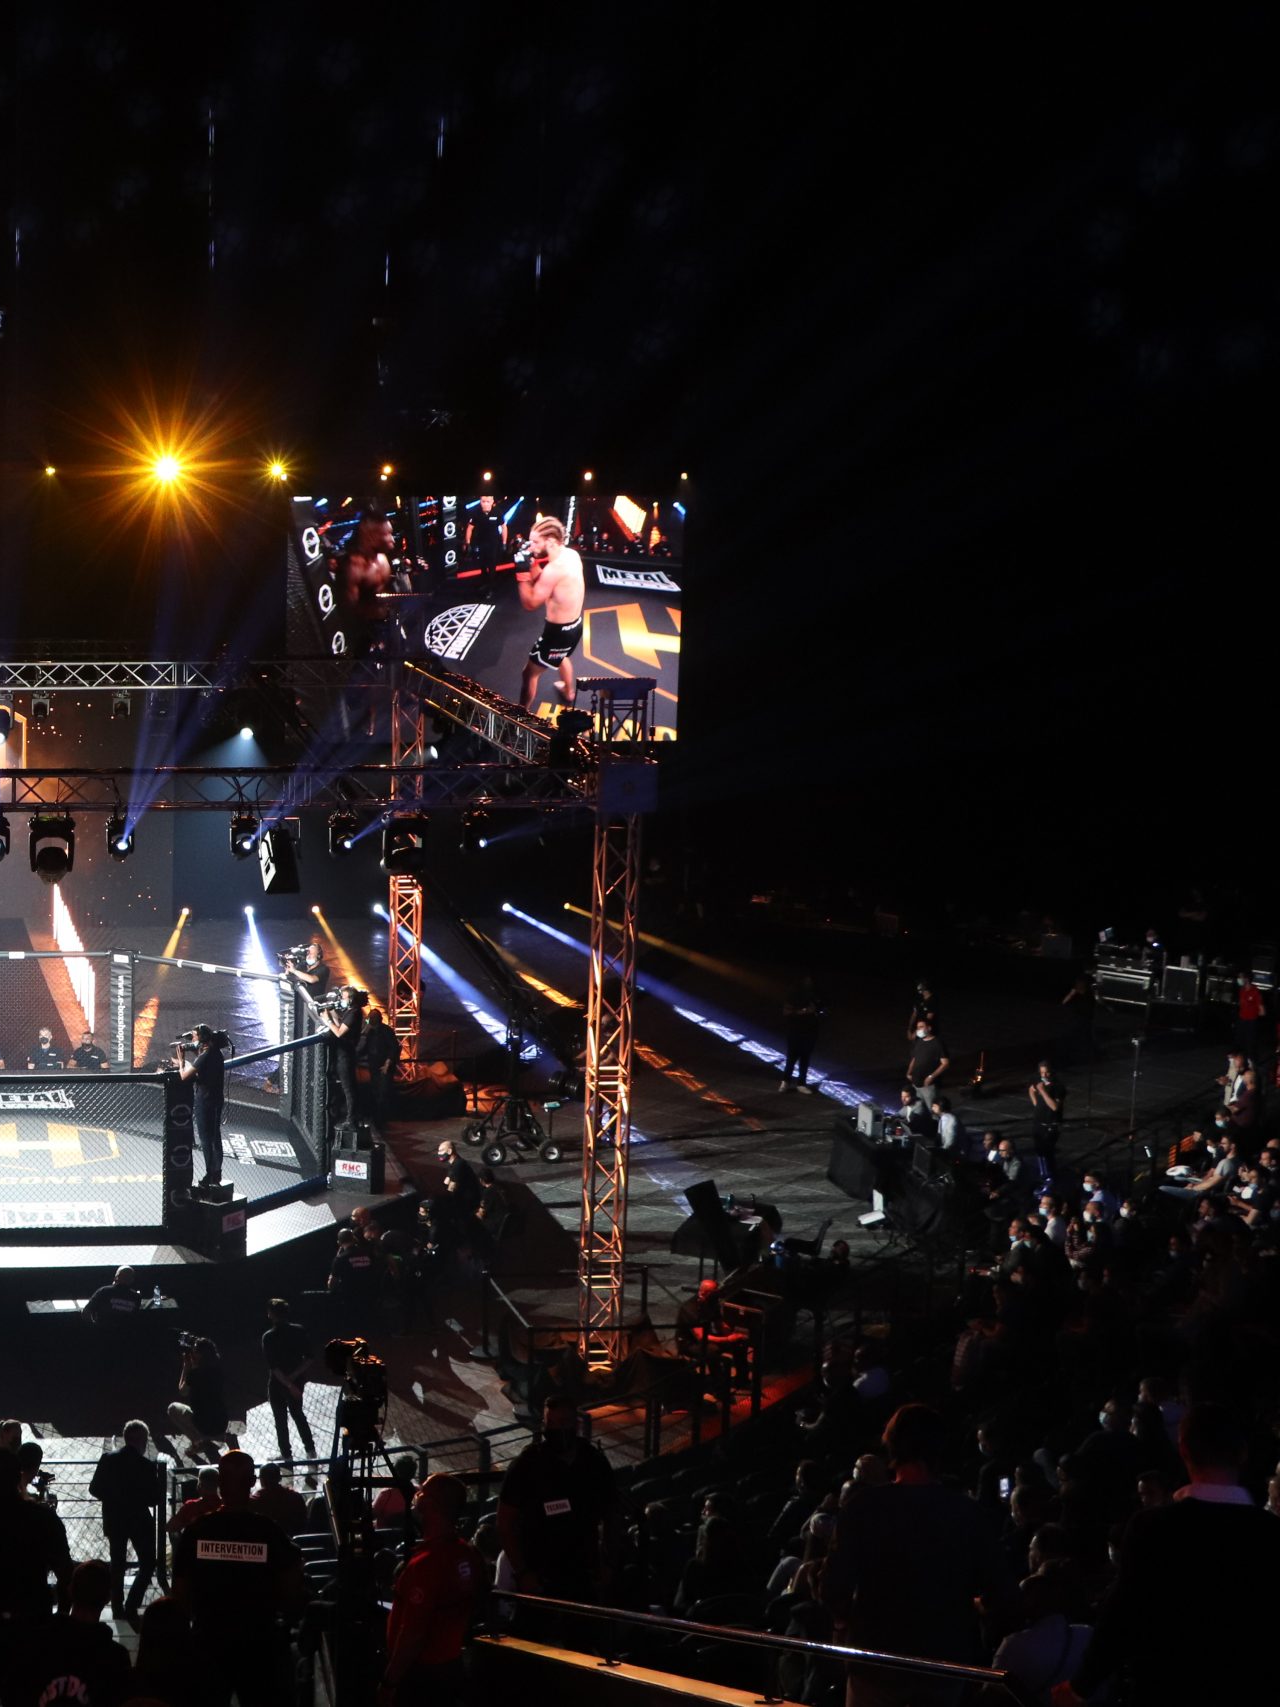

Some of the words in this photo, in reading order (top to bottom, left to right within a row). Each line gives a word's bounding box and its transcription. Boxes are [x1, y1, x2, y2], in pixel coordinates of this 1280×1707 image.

[601, 566, 670, 585] METAL
[342, 1163, 361, 1172] RMC
[201, 1542, 264, 1556] INTERVENTION
